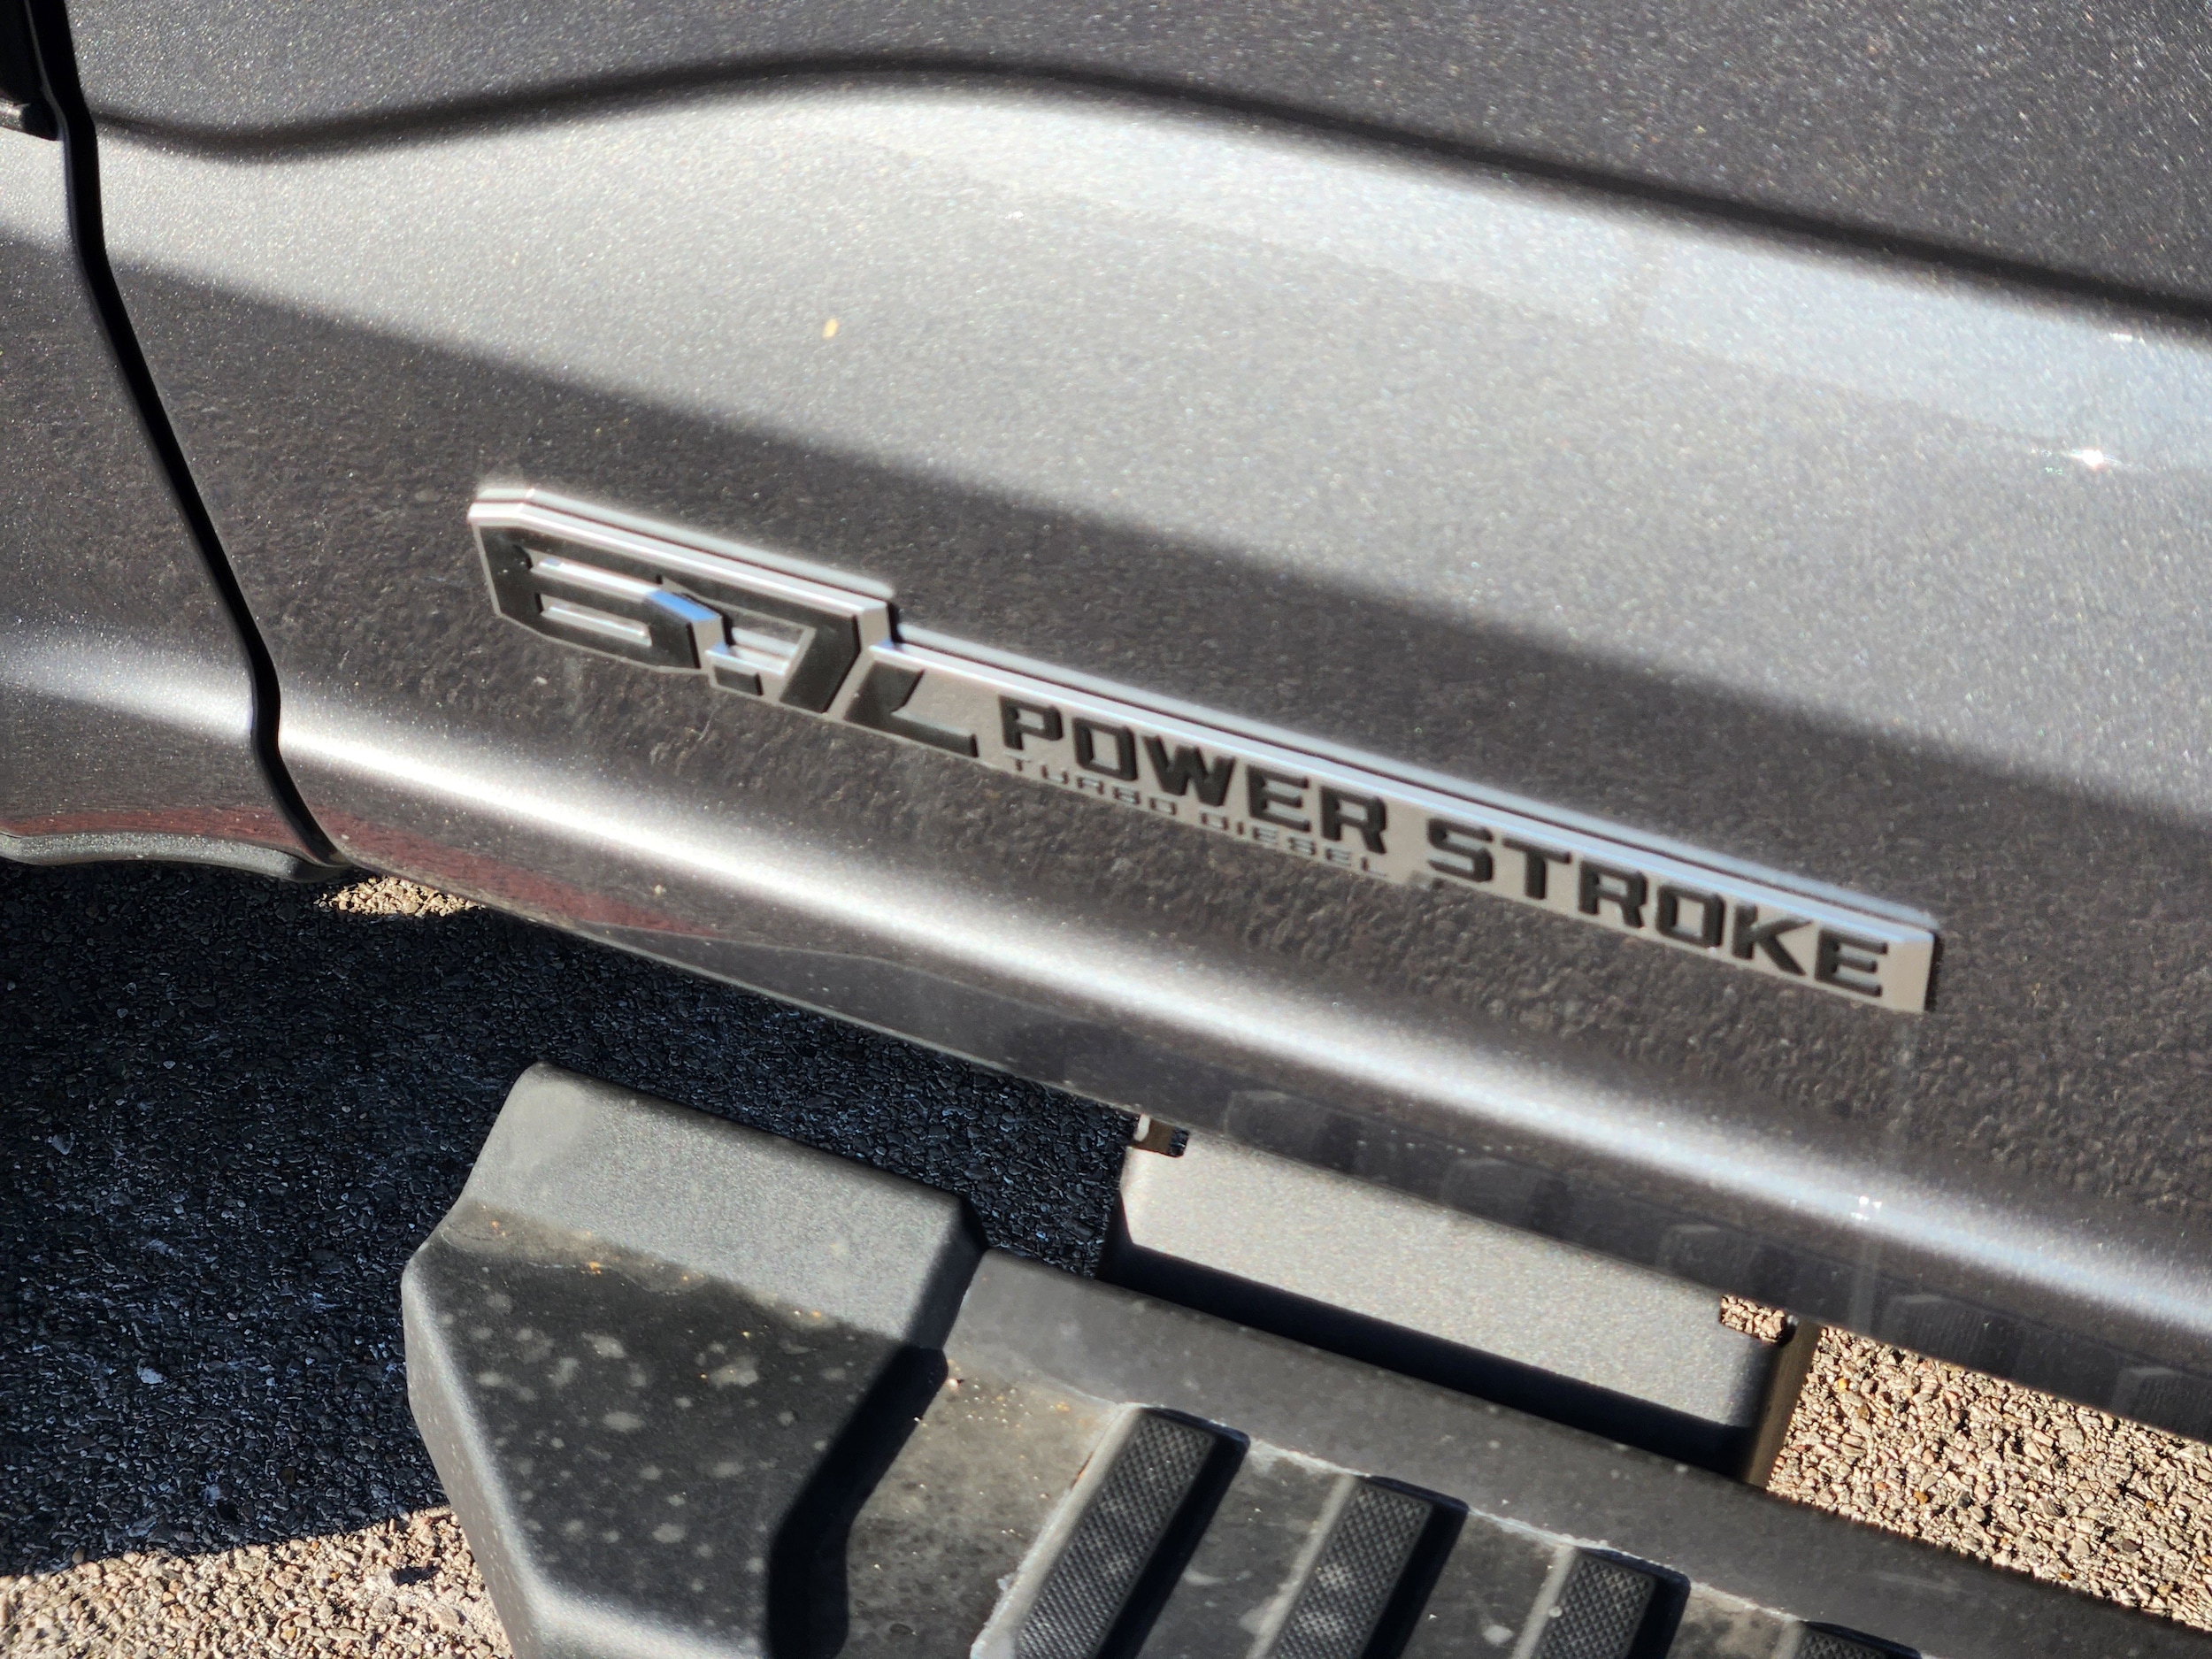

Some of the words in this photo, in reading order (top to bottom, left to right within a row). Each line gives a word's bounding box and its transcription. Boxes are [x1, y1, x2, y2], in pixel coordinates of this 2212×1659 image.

[999, 695, 1387, 854] POWER
[1425, 818, 1888, 998] STROKE
[1004, 751, 1178, 816] TURBO
[1199, 807, 1387, 877] DIESEL
